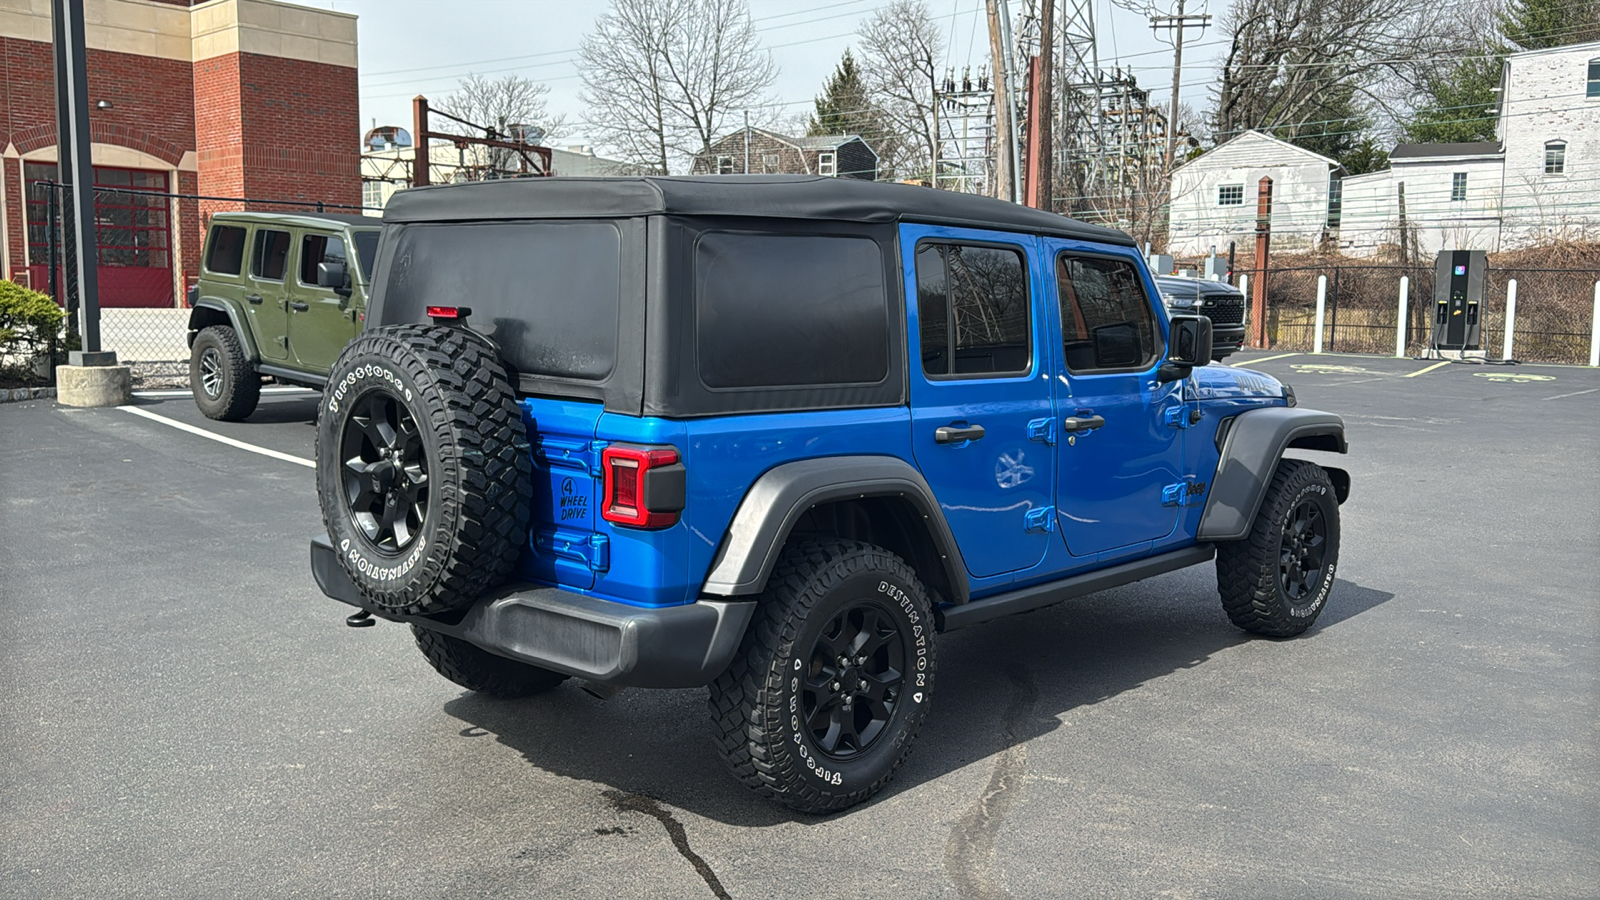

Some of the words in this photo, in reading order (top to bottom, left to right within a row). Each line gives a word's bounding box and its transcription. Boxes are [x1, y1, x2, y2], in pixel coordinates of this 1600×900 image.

[1185, 480, 1206, 496] Jeep
[560, 495, 587, 508] WHEEL
[560, 507, 587, 521] DRIVE
[348, 535, 426, 581] DESTINATION
[877, 580, 927, 687] DESTINATION
